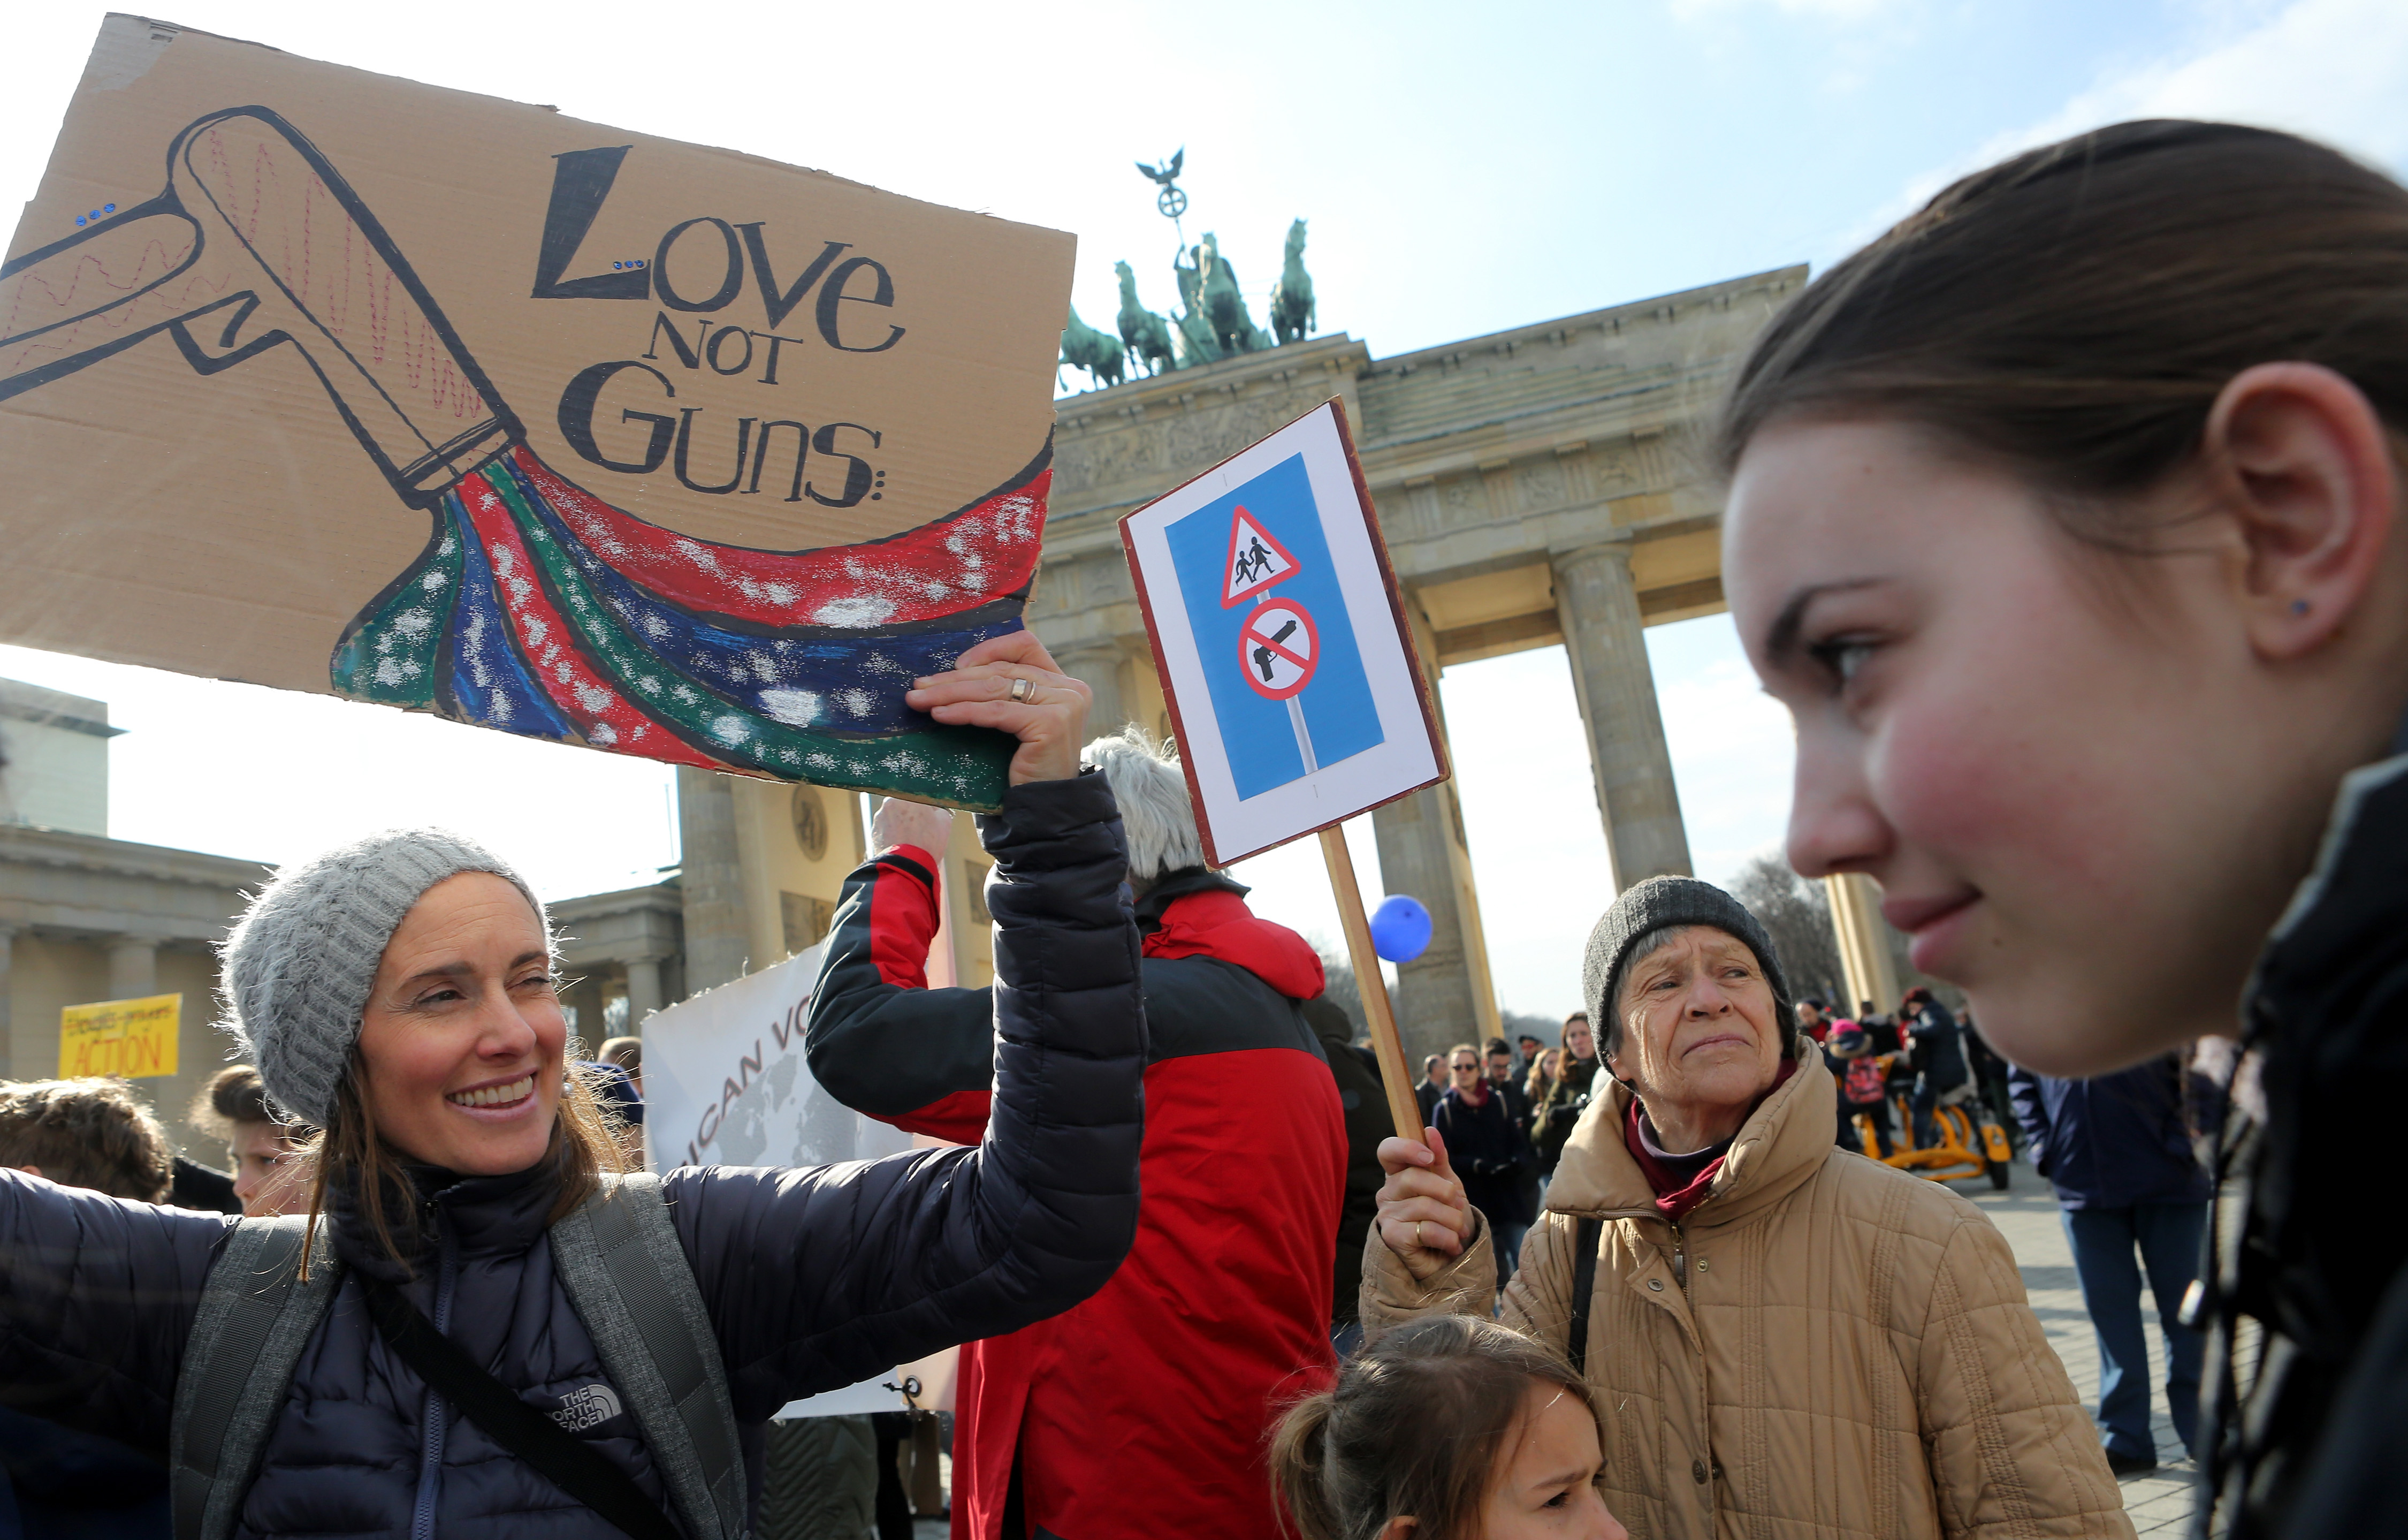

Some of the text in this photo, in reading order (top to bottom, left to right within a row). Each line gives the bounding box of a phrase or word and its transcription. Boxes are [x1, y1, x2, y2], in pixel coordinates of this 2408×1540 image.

[642, 311, 804, 385] NOT
[72, 1033, 162, 1077] ACTION
[681, 1037, 762, 1166] ICAN
[559, 1387, 591, 1407] THE
